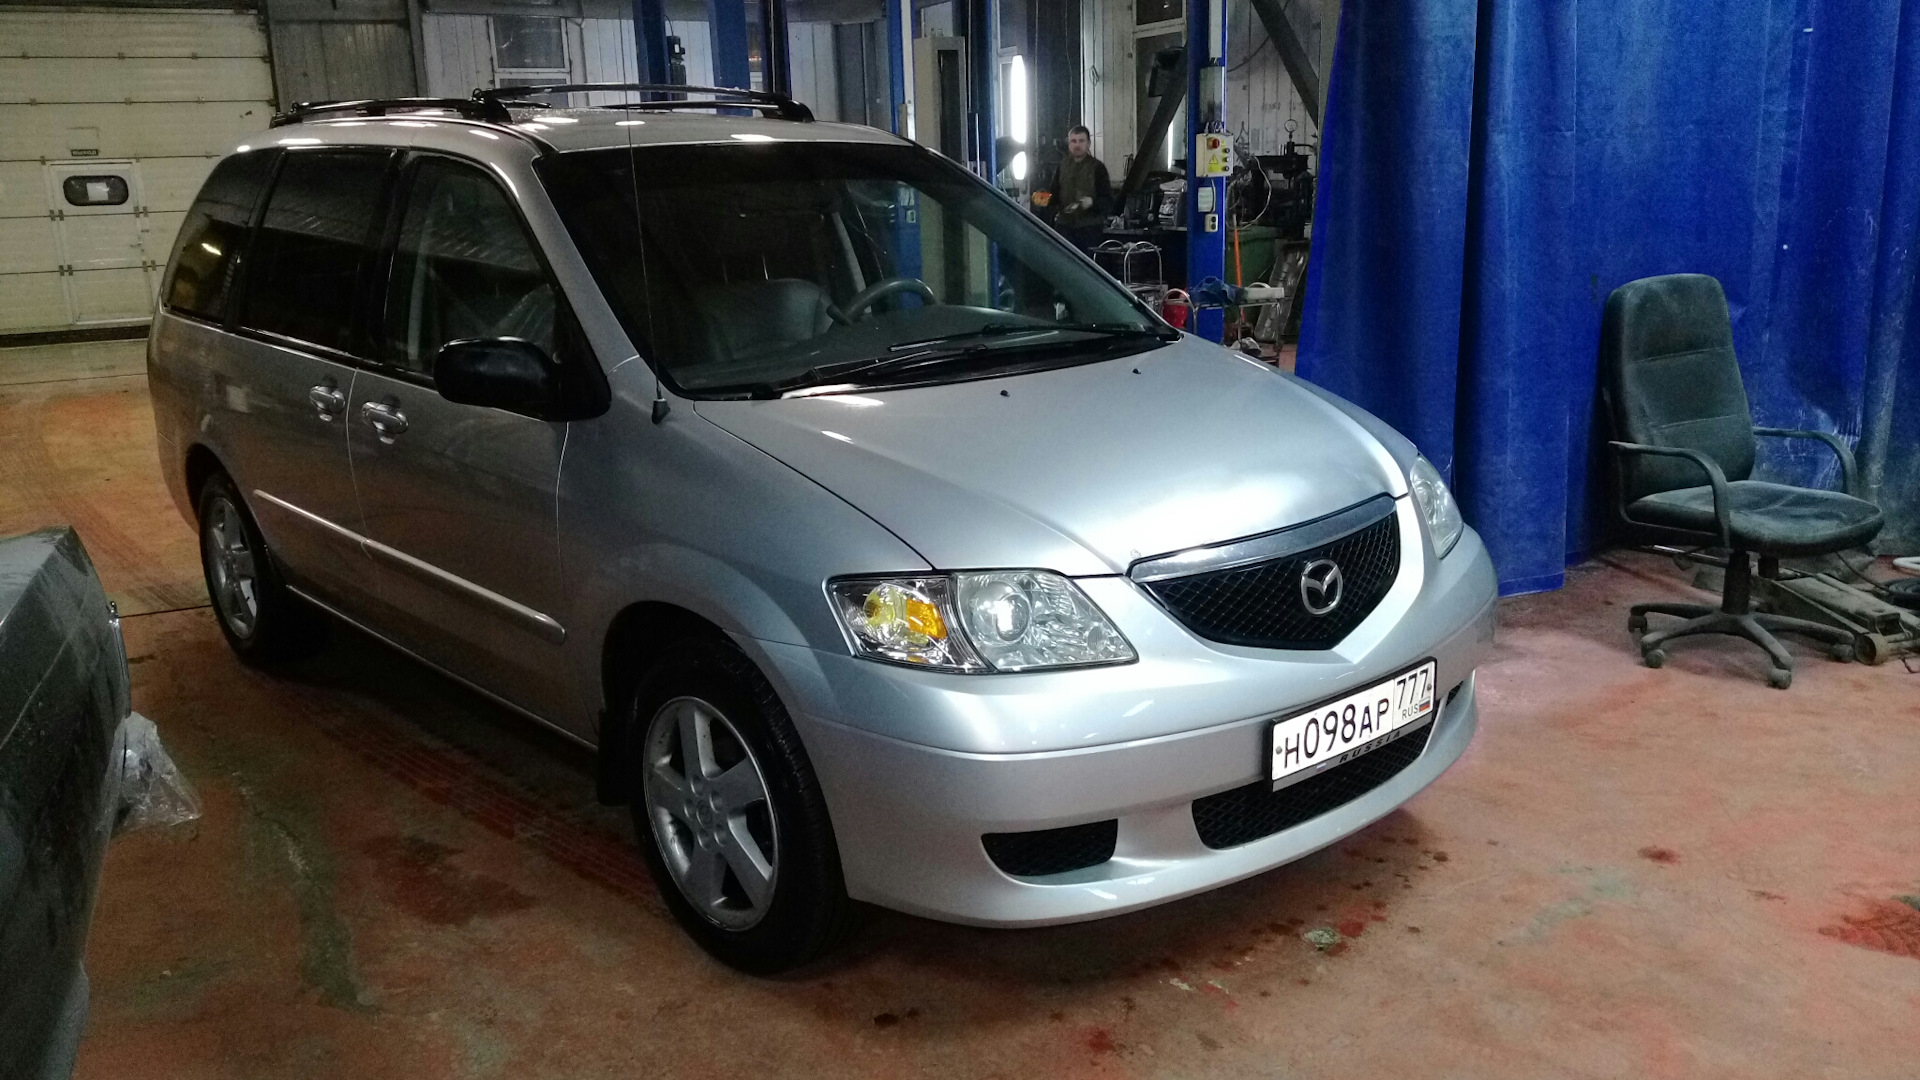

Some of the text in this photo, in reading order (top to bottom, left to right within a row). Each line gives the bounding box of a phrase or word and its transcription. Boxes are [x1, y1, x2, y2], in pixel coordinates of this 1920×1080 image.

[1284, 668, 1428, 769] H098AP 777
[1402, 703, 1418, 720] RUS
[1339, 731, 1400, 763] RUSSIA
